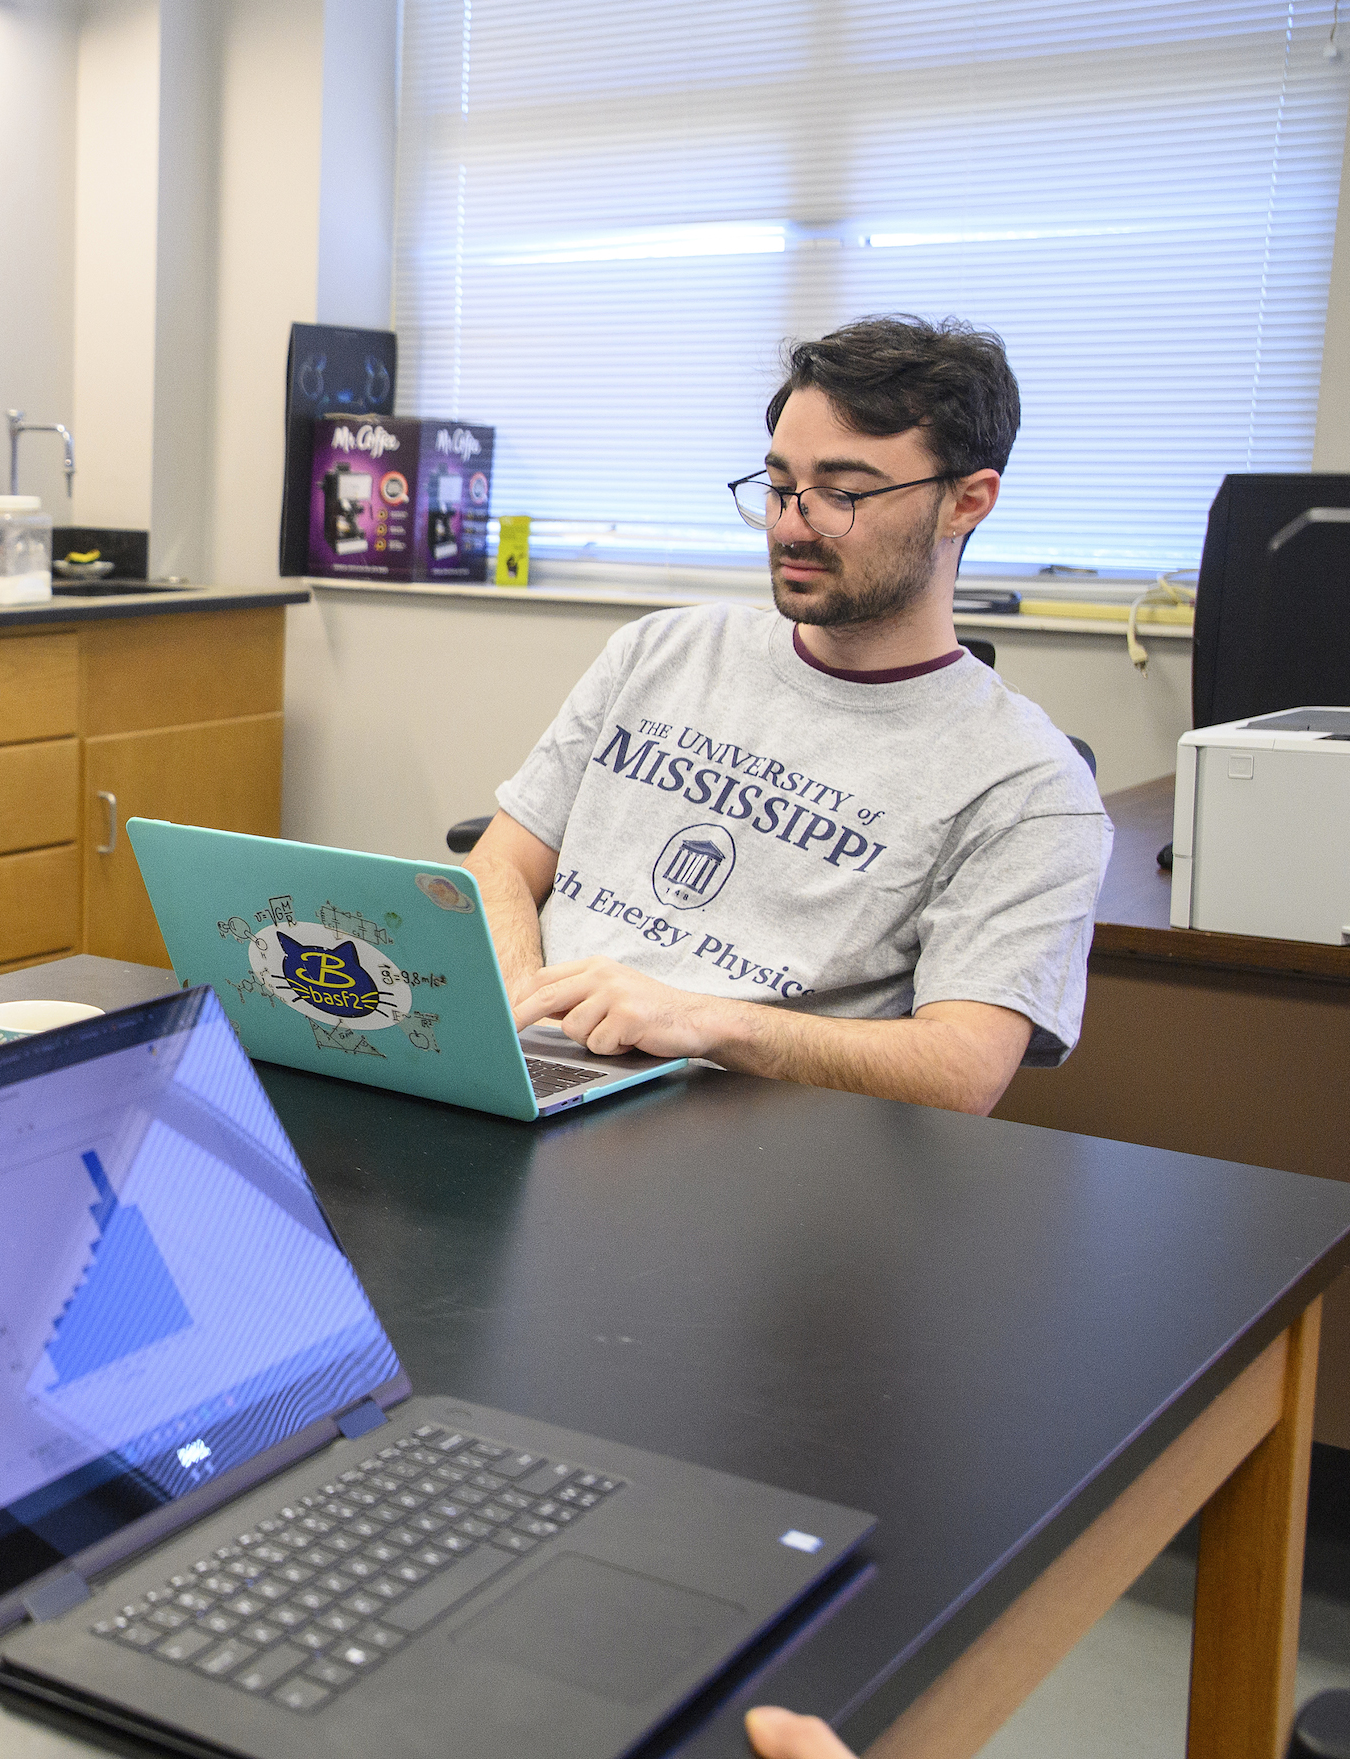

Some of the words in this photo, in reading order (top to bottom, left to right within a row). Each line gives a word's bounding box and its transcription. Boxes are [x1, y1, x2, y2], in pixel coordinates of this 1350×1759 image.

[356, 424, 400, 459] Coffee
[593, 724, 888, 874] MISSISSIPPI
[640, 718, 673, 739] THE
[677, 726, 854, 813] UNIVERSITY
[857, 806, 885, 826] of
[586, 887, 692, 948] Energy
[309, 986, 363, 1010] basf2
